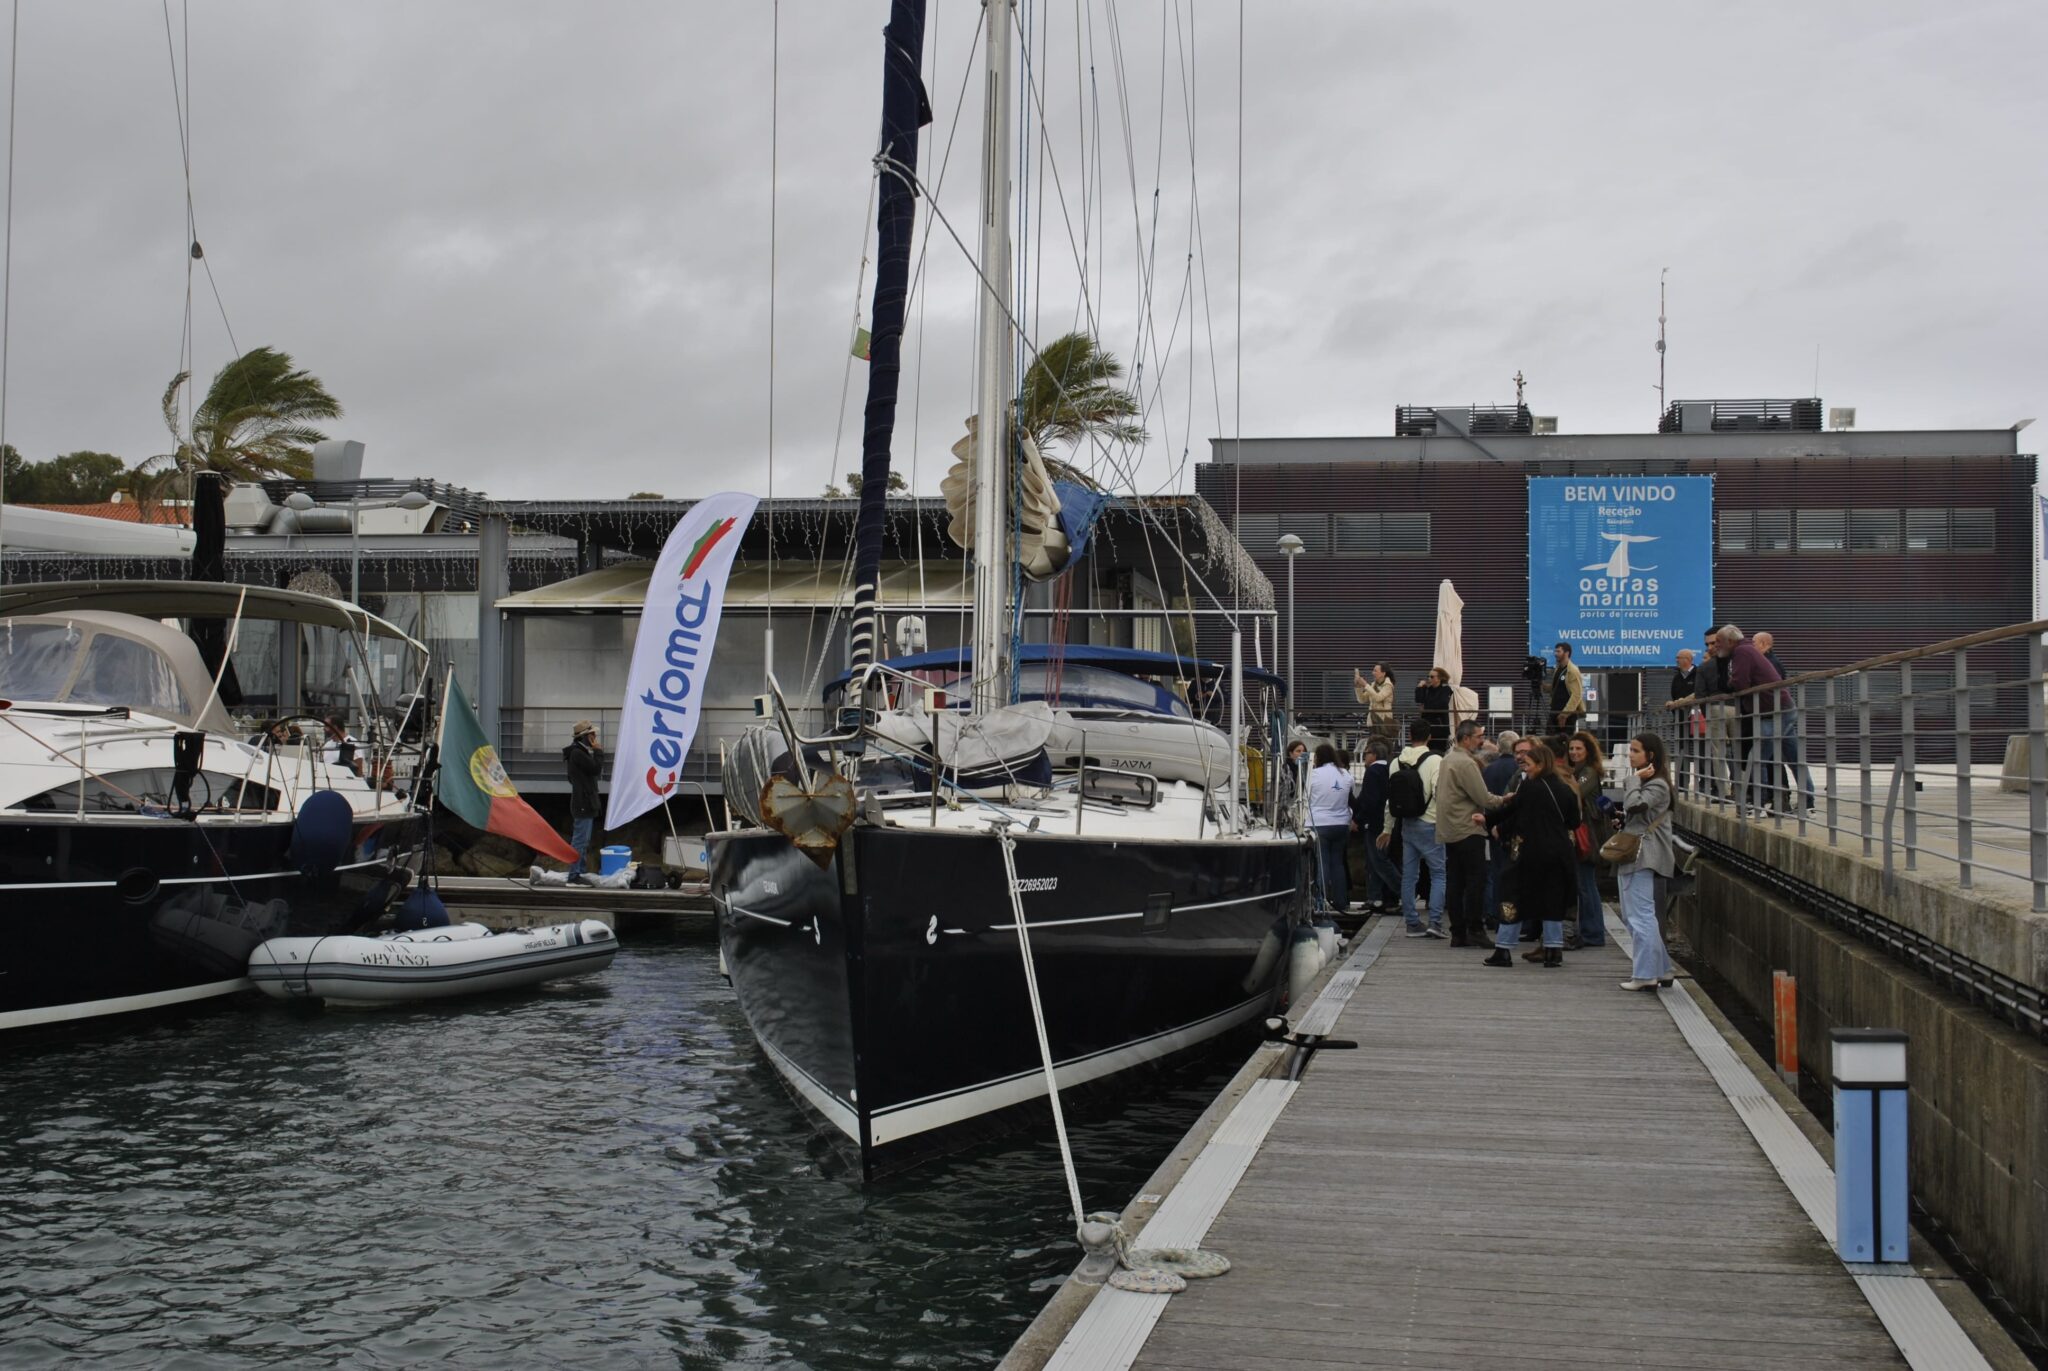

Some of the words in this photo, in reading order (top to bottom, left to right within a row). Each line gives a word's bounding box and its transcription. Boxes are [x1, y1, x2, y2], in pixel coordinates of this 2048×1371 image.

[1564, 486, 1606, 501] BEM
[1612, 486, 1676, 501] VINDO
[1598, 505, 1641, 518] Receção
[1579, 577, 1659, 592] oeiras
[1579, 593, 1659, 606] marina
[1580, 611, 1605, 619] porto
[1558, 629, 1615, 639] WELCOME
[1620, 629, 1684, 639] BIENVENUE
[1581, 645, 1660, 655] WILLKOMMEN
